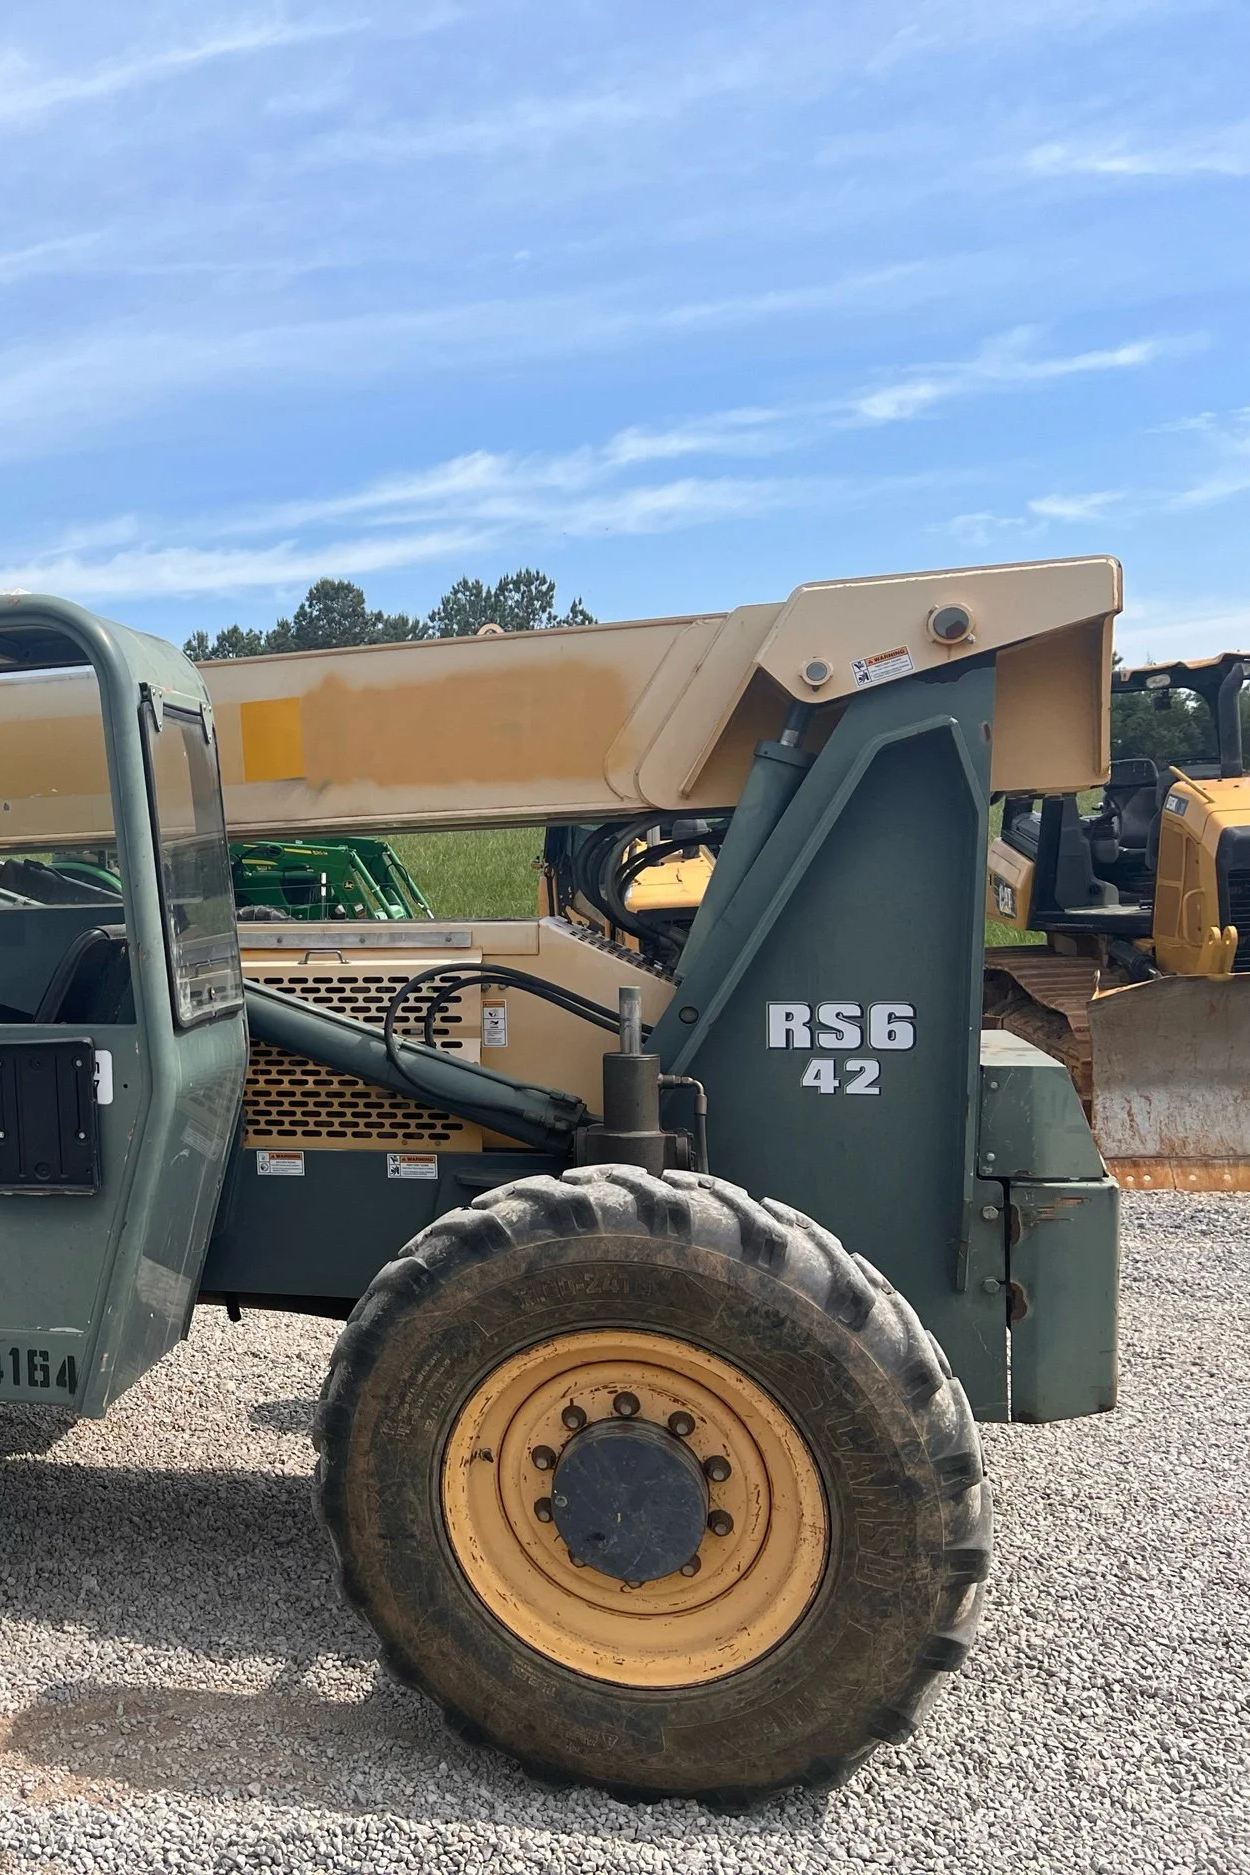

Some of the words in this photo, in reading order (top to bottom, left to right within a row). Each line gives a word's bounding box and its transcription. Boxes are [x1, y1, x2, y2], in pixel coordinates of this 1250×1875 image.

[873, 648, 906, 662] WARNING
[766, 1001, 918, 1051] RS6
[801, 1057, 882, 1096] 42
